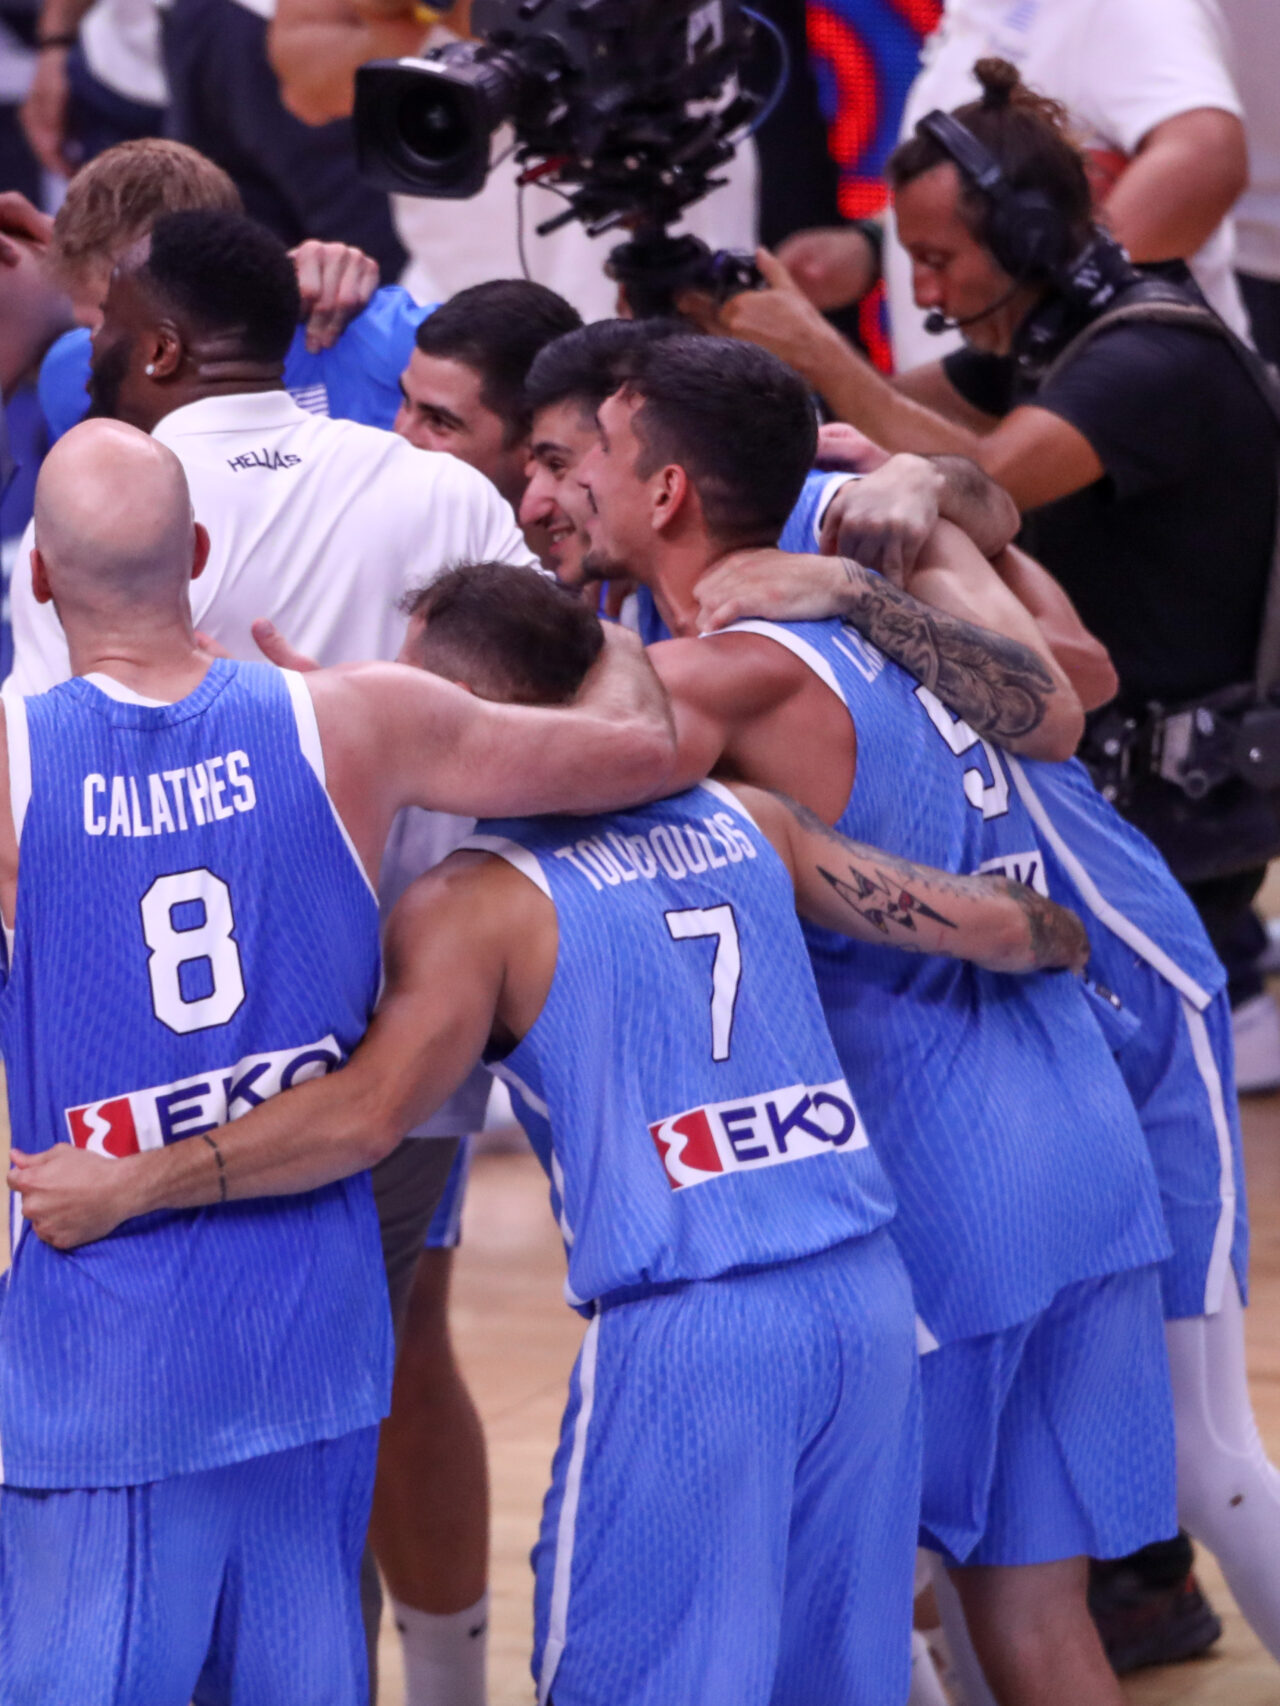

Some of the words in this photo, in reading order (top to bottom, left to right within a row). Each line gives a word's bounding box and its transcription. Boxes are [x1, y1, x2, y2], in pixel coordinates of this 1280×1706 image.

[227, 447, 302, 472] HELLAS
[83, 750, 257, 837] CALATHES
[139, 867, 247, 1036] 8
[664, 903, 741, 1062] 7
[719, 1091, 856, 1162] EKO
